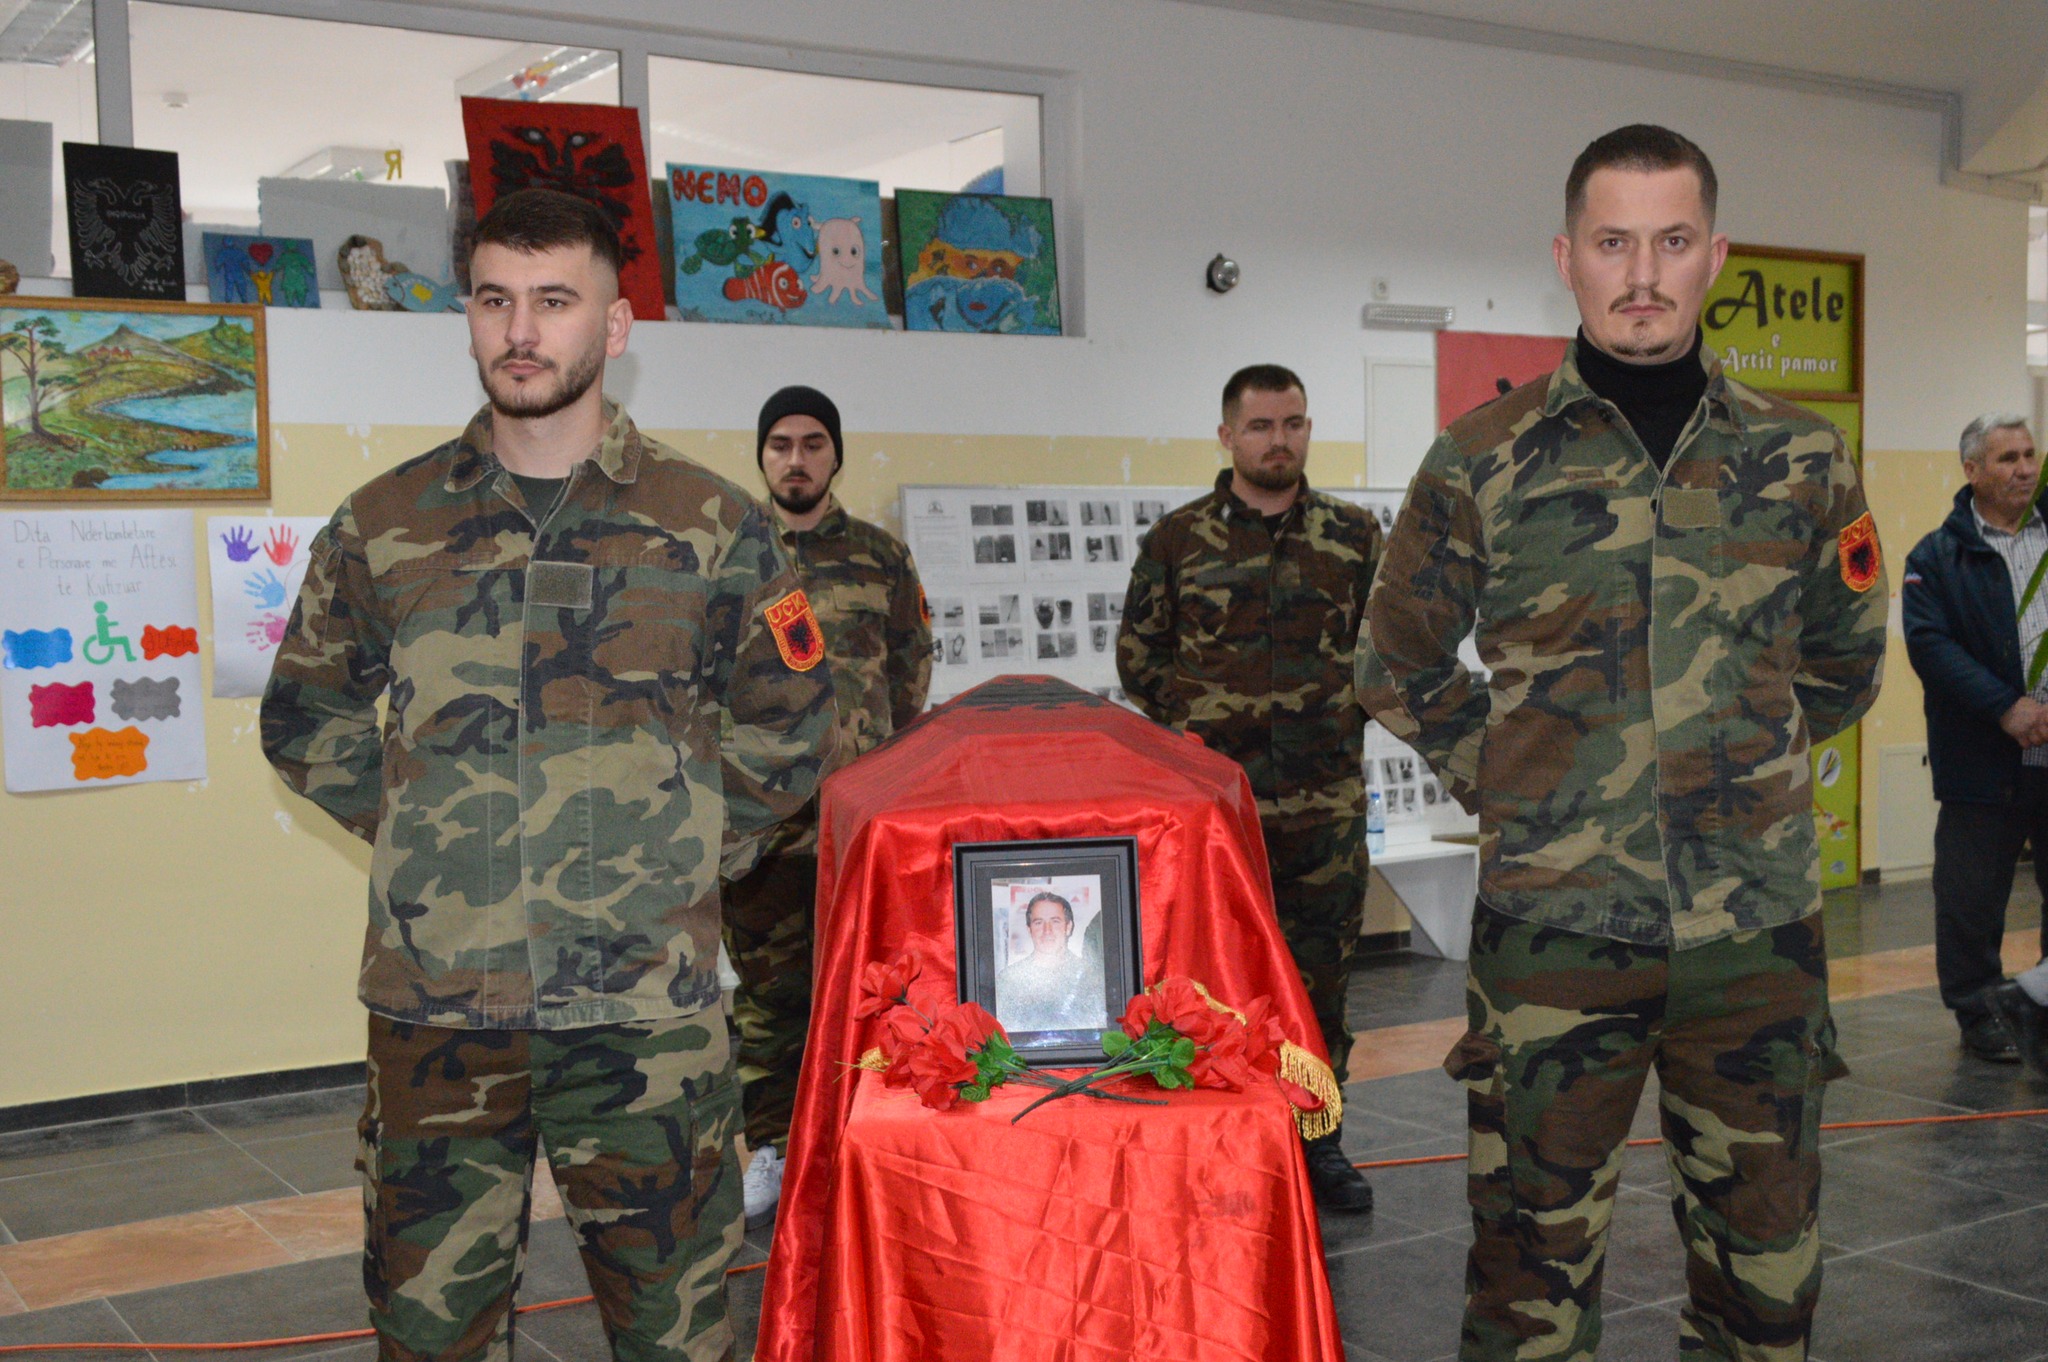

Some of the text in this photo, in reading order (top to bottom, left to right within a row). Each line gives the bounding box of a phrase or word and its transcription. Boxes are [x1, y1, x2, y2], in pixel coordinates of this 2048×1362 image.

[672, 167, 768, 208] NEMO
[1705, 269, 1844, 330] Atele
[1771, 333, 1781, 348] e
[1720, 347, 1838, 378] Artit pamor
[13, 519, 52, 543] Dita
